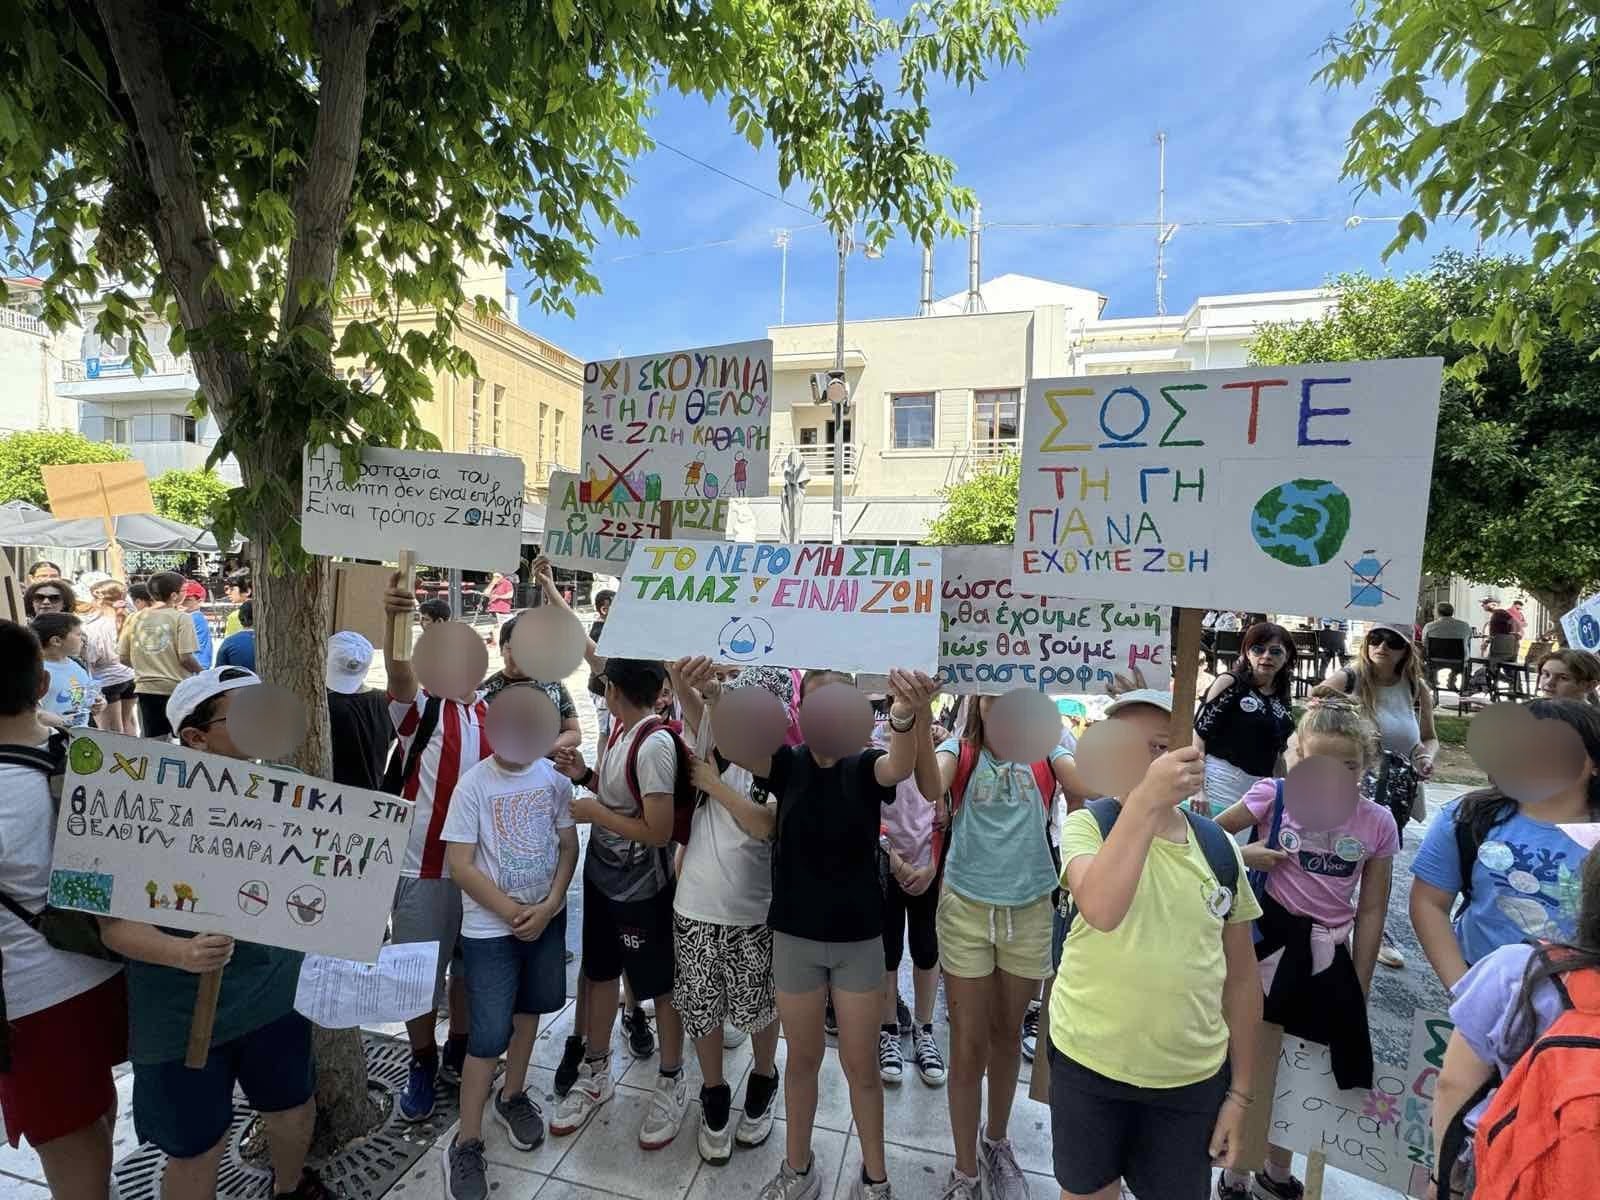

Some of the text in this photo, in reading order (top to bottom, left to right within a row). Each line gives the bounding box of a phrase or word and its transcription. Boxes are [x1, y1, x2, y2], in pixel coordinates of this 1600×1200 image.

[584, 361, 631, 395] ΟΧΙ
[648, 391, 676, 422] ΓΗ
[685, 389, 769, 425] ΘΕΛΟΥ
[1039, 378, 1351, 452] ΣΩΣΤΕ
[583, 421, 770, 451] ΜΕ ΖΩΗ ΚΑΘΑΡΗ
[395, 477, 425, 498] δεν
[458, 470, 489, 485] του
[1038, 466, 1204, 504] ΤΗ ΓΗ
[1029, 507, 1162, 546] ΓΙΑ ΝΑ
[644, 545, 697, 571] ΤΟ
[705, 544, 792, 575] ΝΕΡΟ
[794, 546, 845, 577] ΜΗ
[1023, 548, 1208, 574] ΕΧΟΥΜΕ ΖΩΗ
[771, 578, 859, 613] ΕΙΝΑΙ
[860, 580, 934, 613] ΖΩΗ
[996, 601, 1090, 636] έχουμε
[997, 632, 1031, 656] θα
[1039, 633, 1115, 663] ζούμε
[1128, 643, 1164, 670] με
[69, 737, 148, 781] ΟΧΙ
[369, 801, 408, 824] ΣΤΗ
[189, 834, 272, 864] ΚΑΘΑΡΑ
[312, 826, 393, 864] ΨΑΡΙΑ
